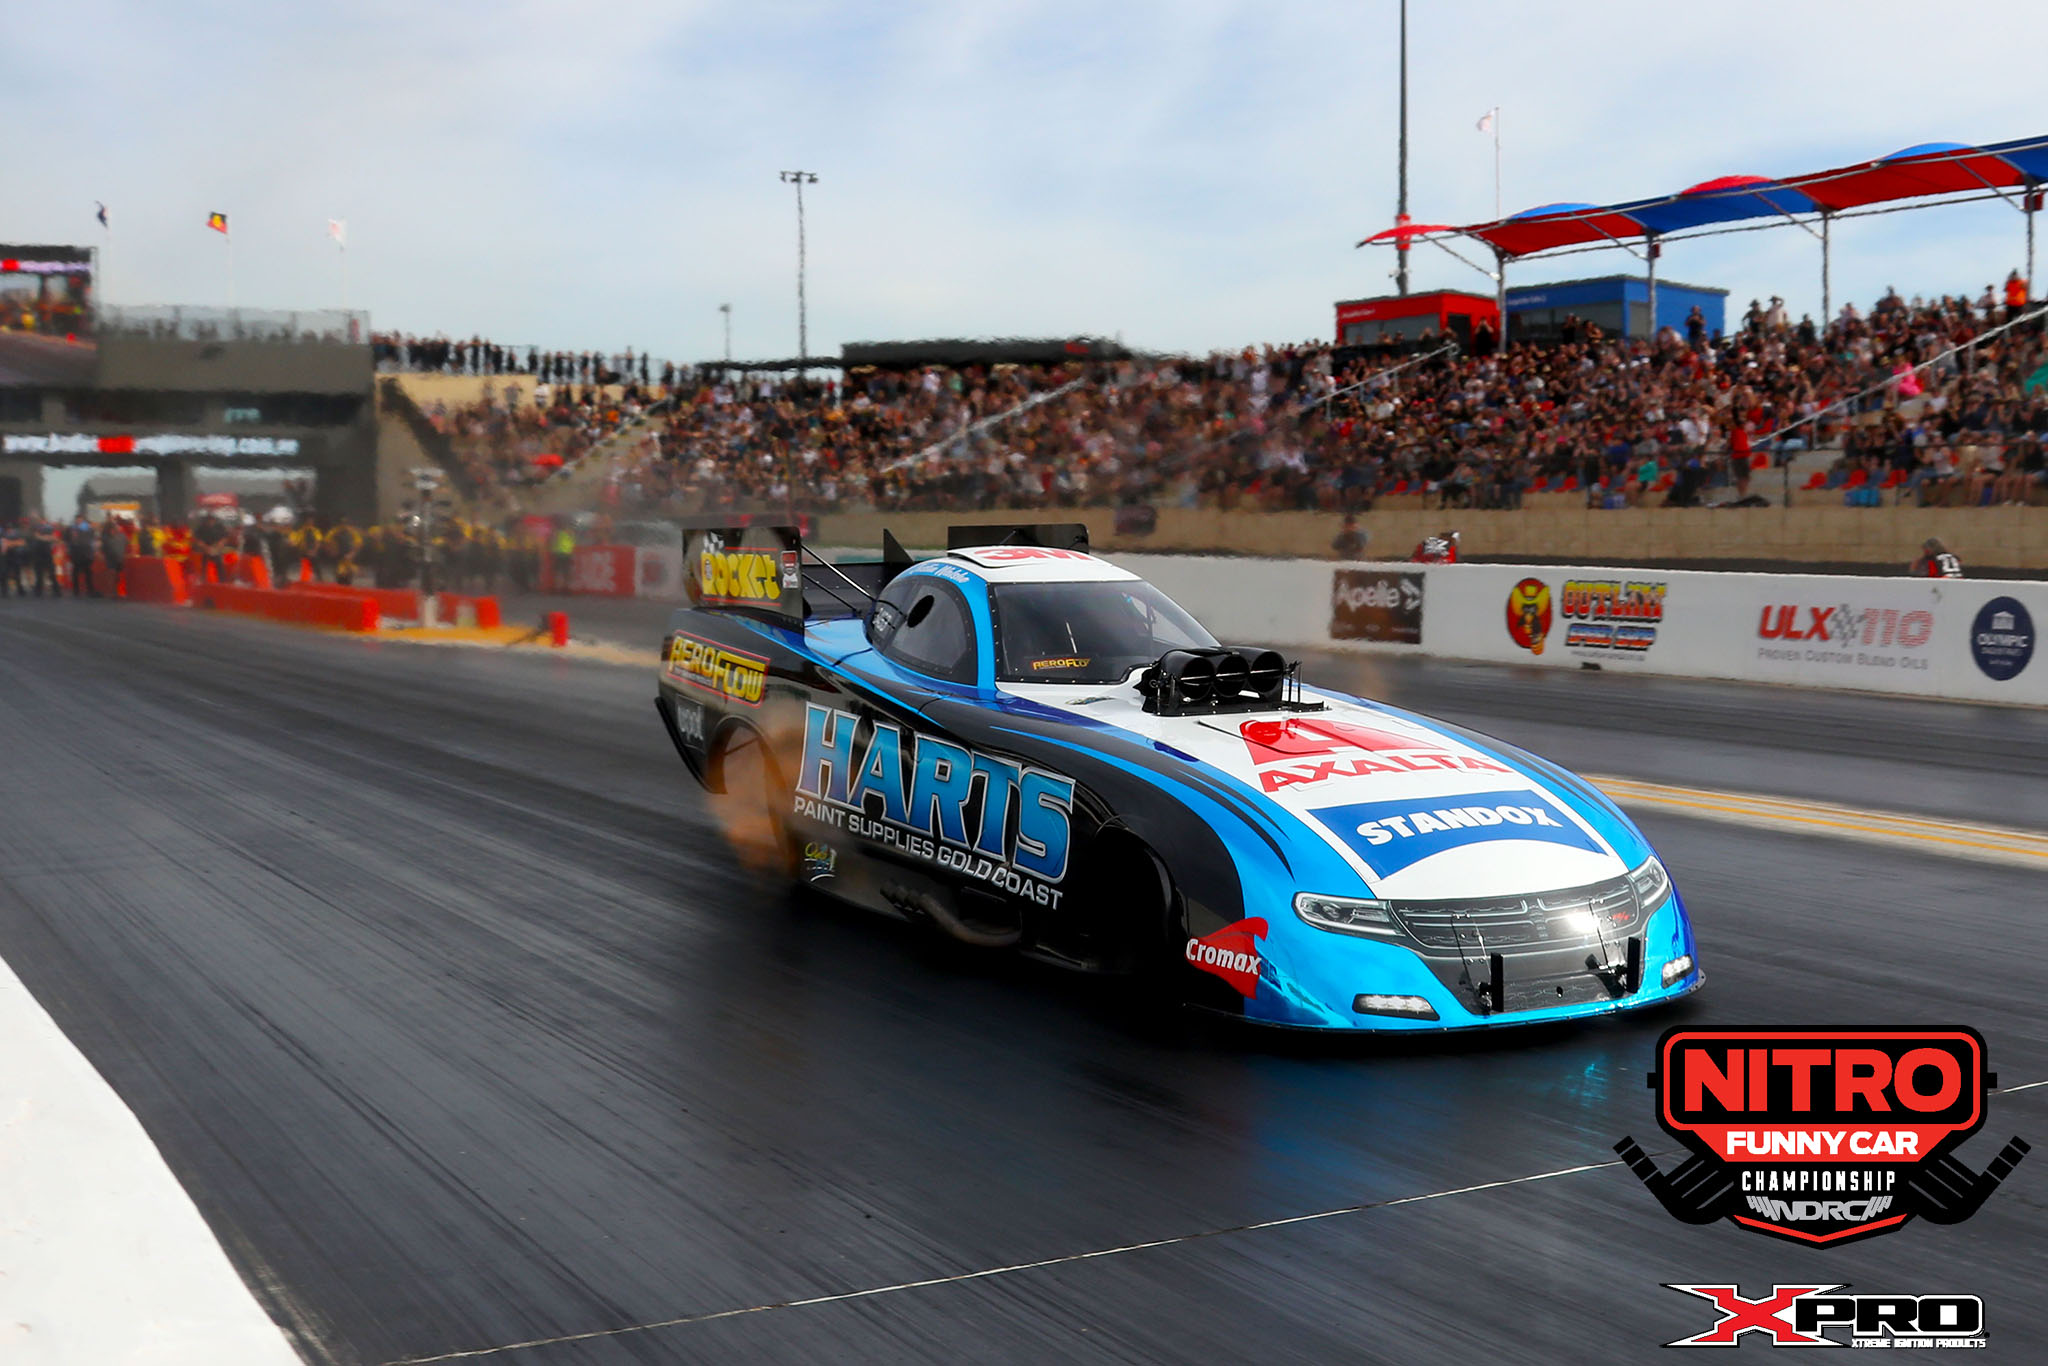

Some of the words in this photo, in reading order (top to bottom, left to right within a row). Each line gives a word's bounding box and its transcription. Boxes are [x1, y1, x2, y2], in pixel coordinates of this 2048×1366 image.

[974, 548, 1093, 561] 3M
[1561, 580, 1667, 622] OUTLAW
[1757, 605, 1836, 641] ULX
[1858, 608, 1935, 648] 110
[668, 636, 766, 702] AEROFLOW
[796, 701, 1076, 884] HARTS
[1258, 754, 1514, 793] AXALTA
[1356, 806, 1564, 846] STANDOX
[794, 796, 846, 828] PAINT
[848, 814, 936, 859] SUPPLIES
[936, 846, 993, 880] GOLD
[990, 866, 1064, 910] COAST
[1185, 938, 1262, 976] Cromax
